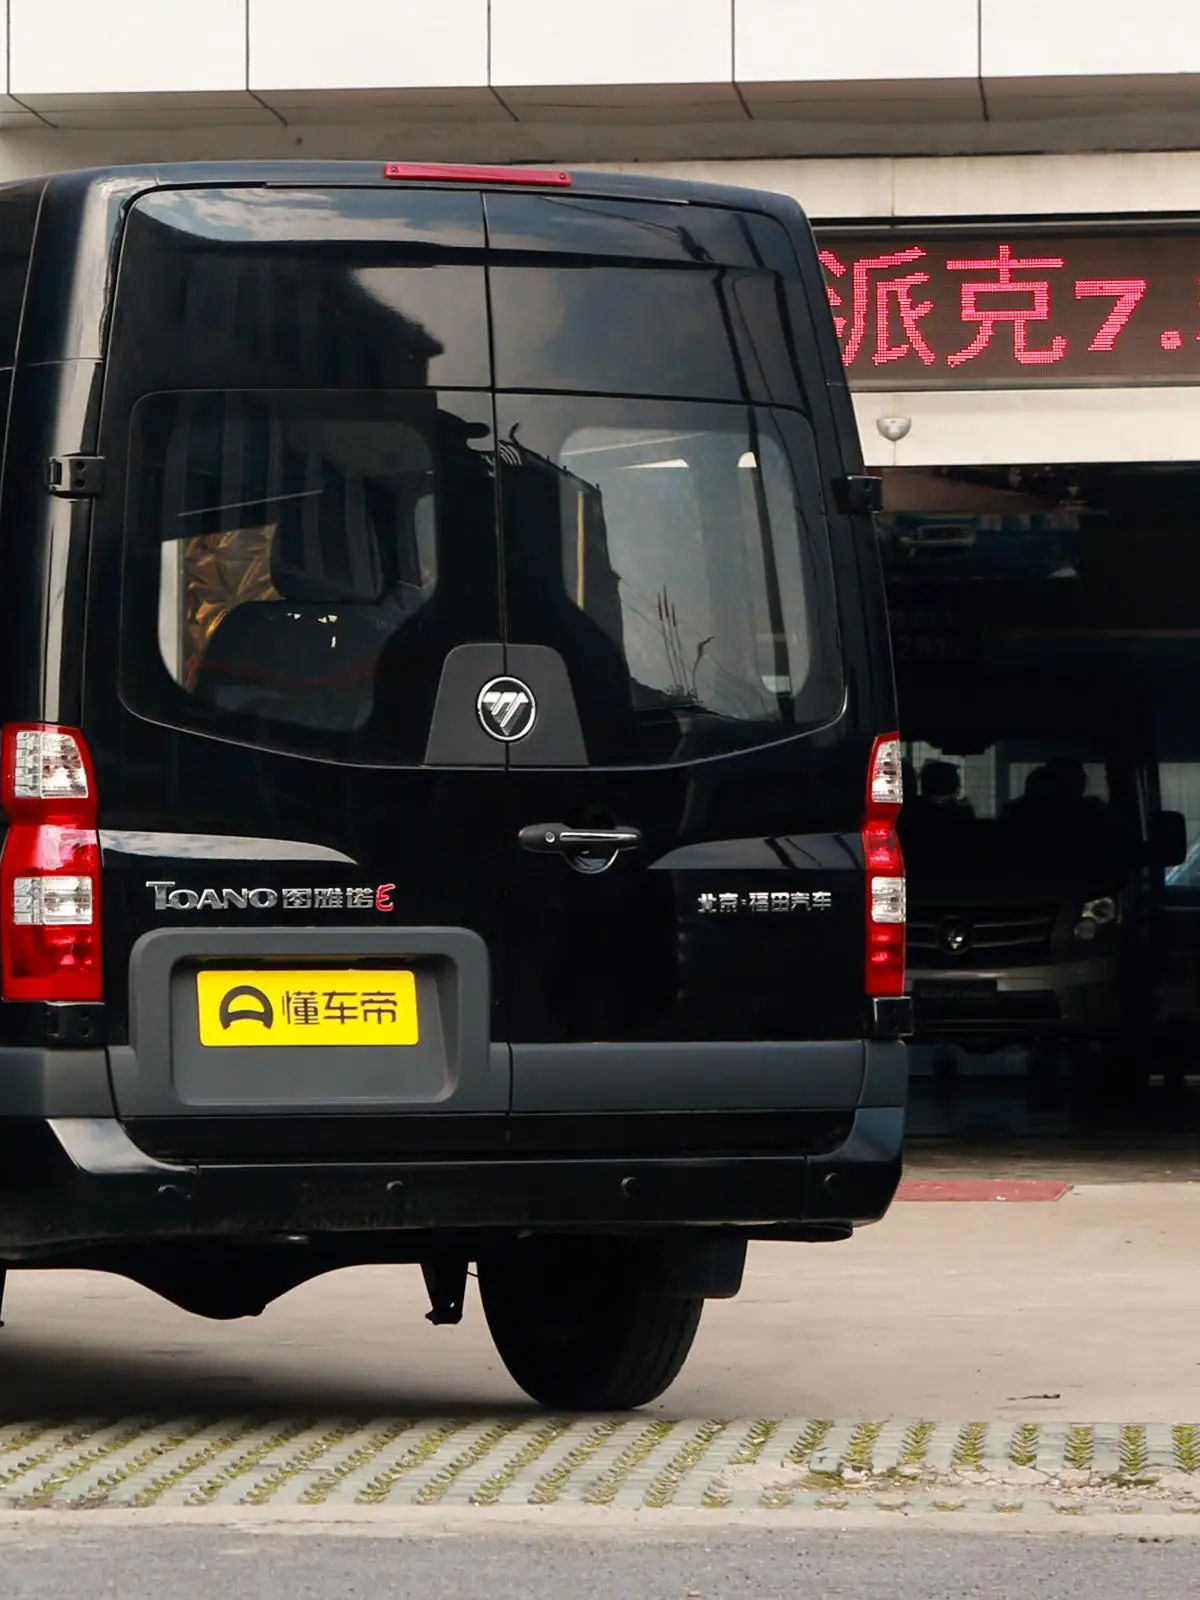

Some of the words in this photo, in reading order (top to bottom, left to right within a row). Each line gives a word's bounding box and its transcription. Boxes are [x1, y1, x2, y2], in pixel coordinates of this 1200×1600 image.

[818, 244, 1200, 367] 派克7.
[146, 881, 278, 911] TOANO
[282, 990, 398, 1025] 懂车帝
